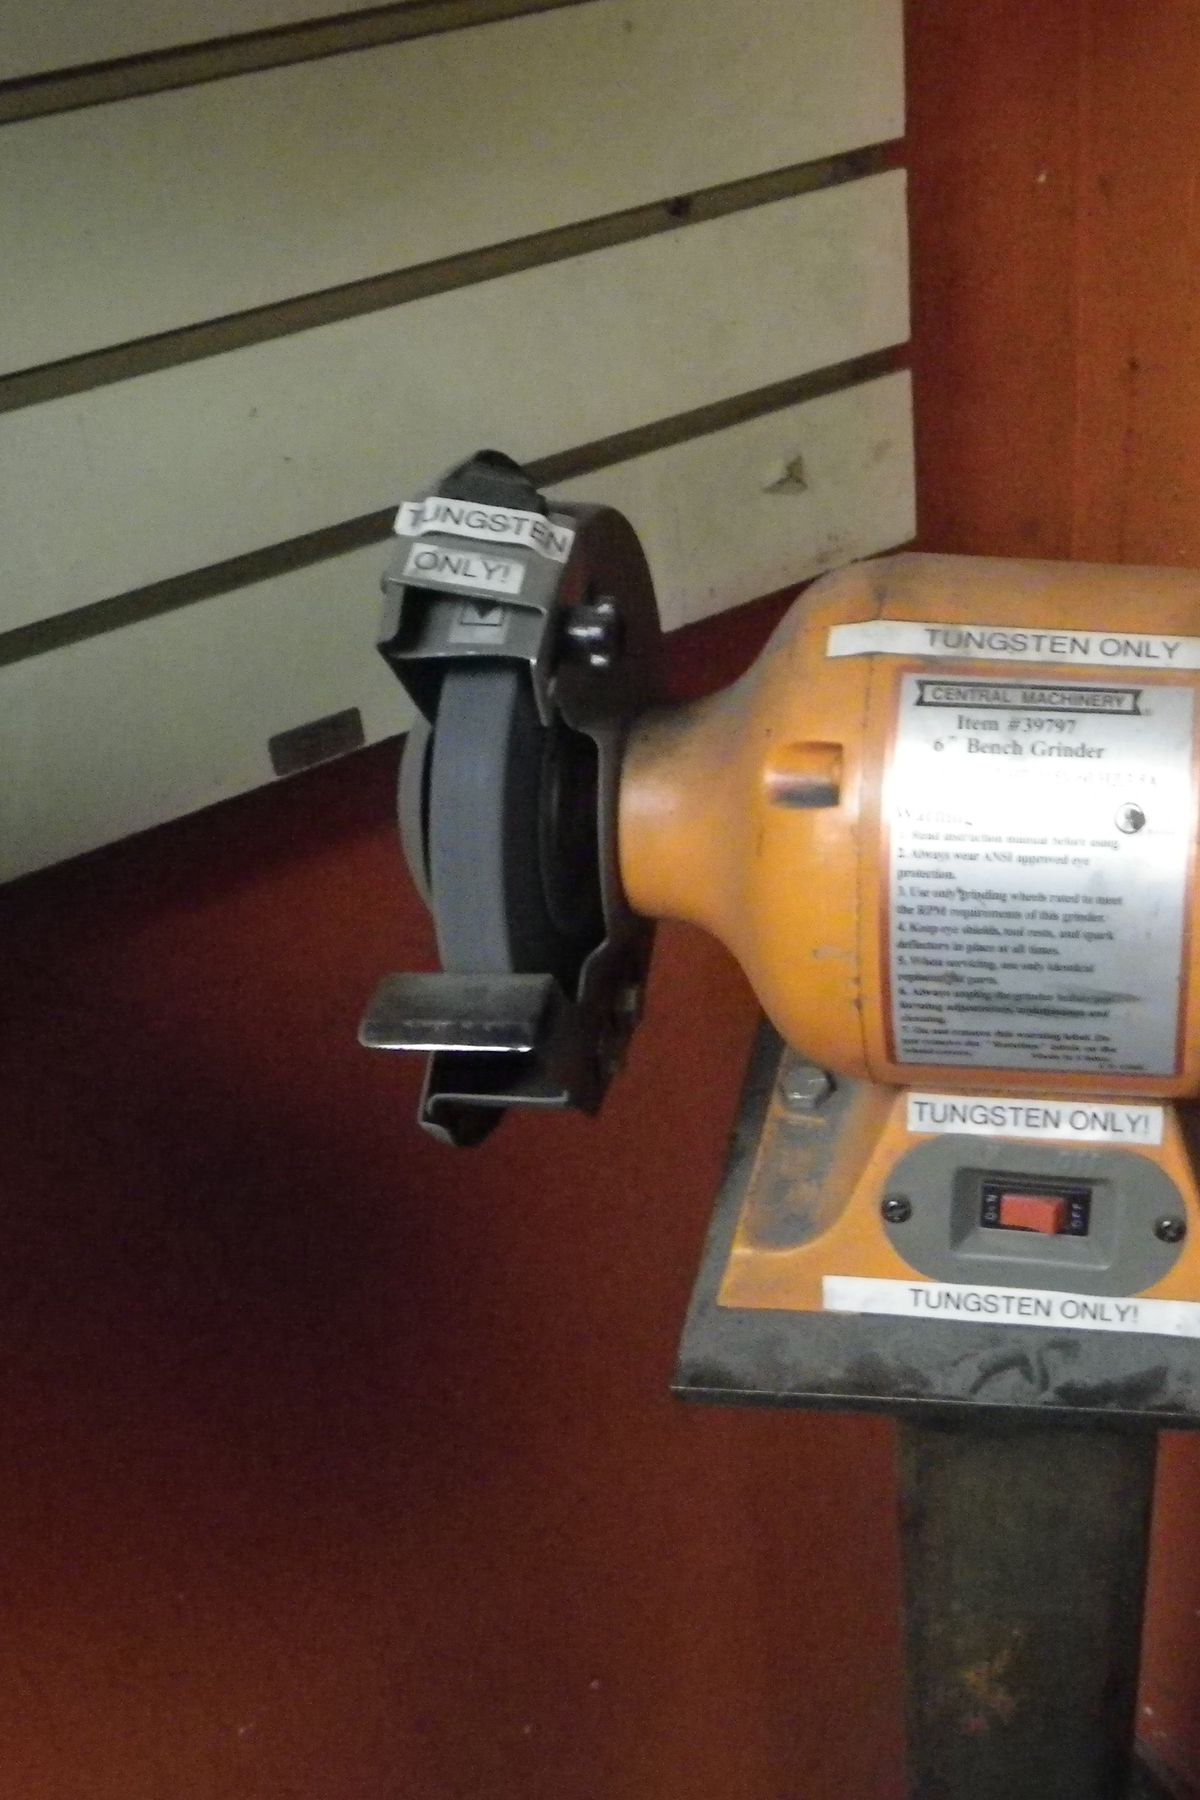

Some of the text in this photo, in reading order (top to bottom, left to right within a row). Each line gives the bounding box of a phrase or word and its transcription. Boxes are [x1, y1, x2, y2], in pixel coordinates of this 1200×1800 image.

[409, 504, 570, 553] TUNGSTEN
[414, 551, 512, 583] ONLY!
[924, 627, 1182, 660] TUNGSTEN ONLY
[931, 686, 1125, 708] CENTRAL MACHINERY
[957, 714, 999, 731] Item
[967, 737, 1023, 756] Bench
[1031, 740, 1105, 759] Grinder
[912, 1101, 1150, 1135] TUNGSTEN ONLY!
[908, 1288, 1140, 1324] TUNGSTEN ONLY!
